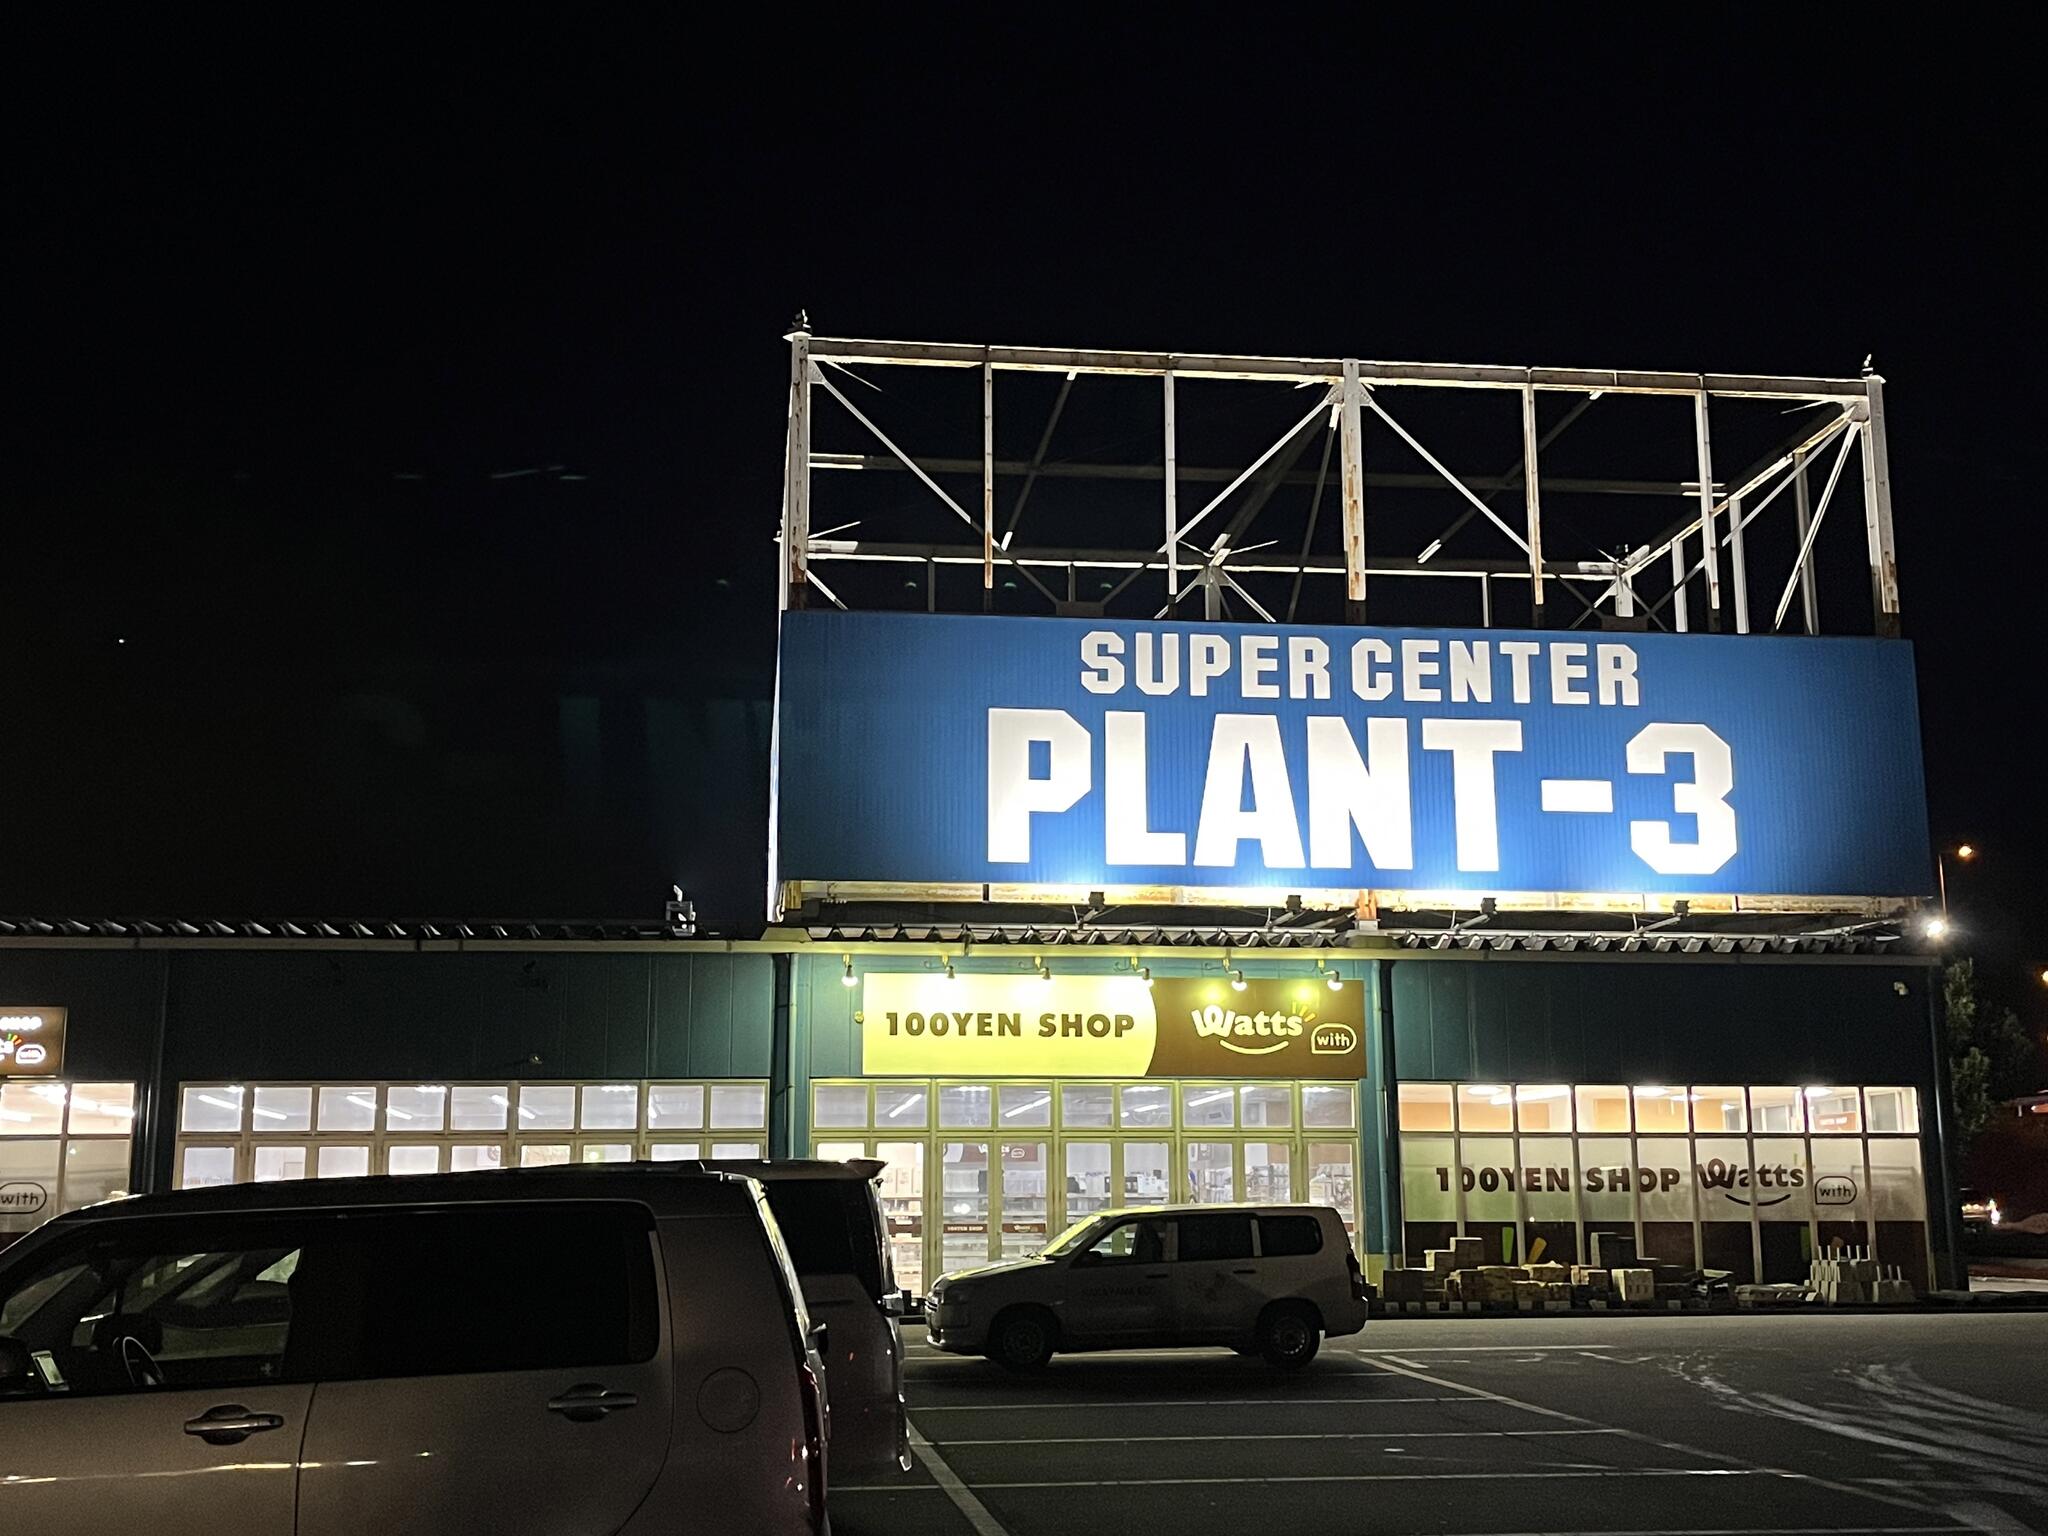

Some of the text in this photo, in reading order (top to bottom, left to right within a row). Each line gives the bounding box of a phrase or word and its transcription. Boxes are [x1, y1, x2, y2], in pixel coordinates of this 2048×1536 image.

[1080, 630, 1640, 706] SUPER CENTER
[987, 707, 1738, 876] PLANT-3
[886, 1012, 1135, 1038] 100YEN SHOP
[1191, 1004, 1304, 1038] Watts
[1317, 1032, 1350, 1047] with
[1436, 1167, 1680, 1192] 100YEN SHOP
[1696, 1158, 1805, 1190] Watts
[0, 1192, 39, 1206] with
[1819, 1185, 1851, 1198] with
